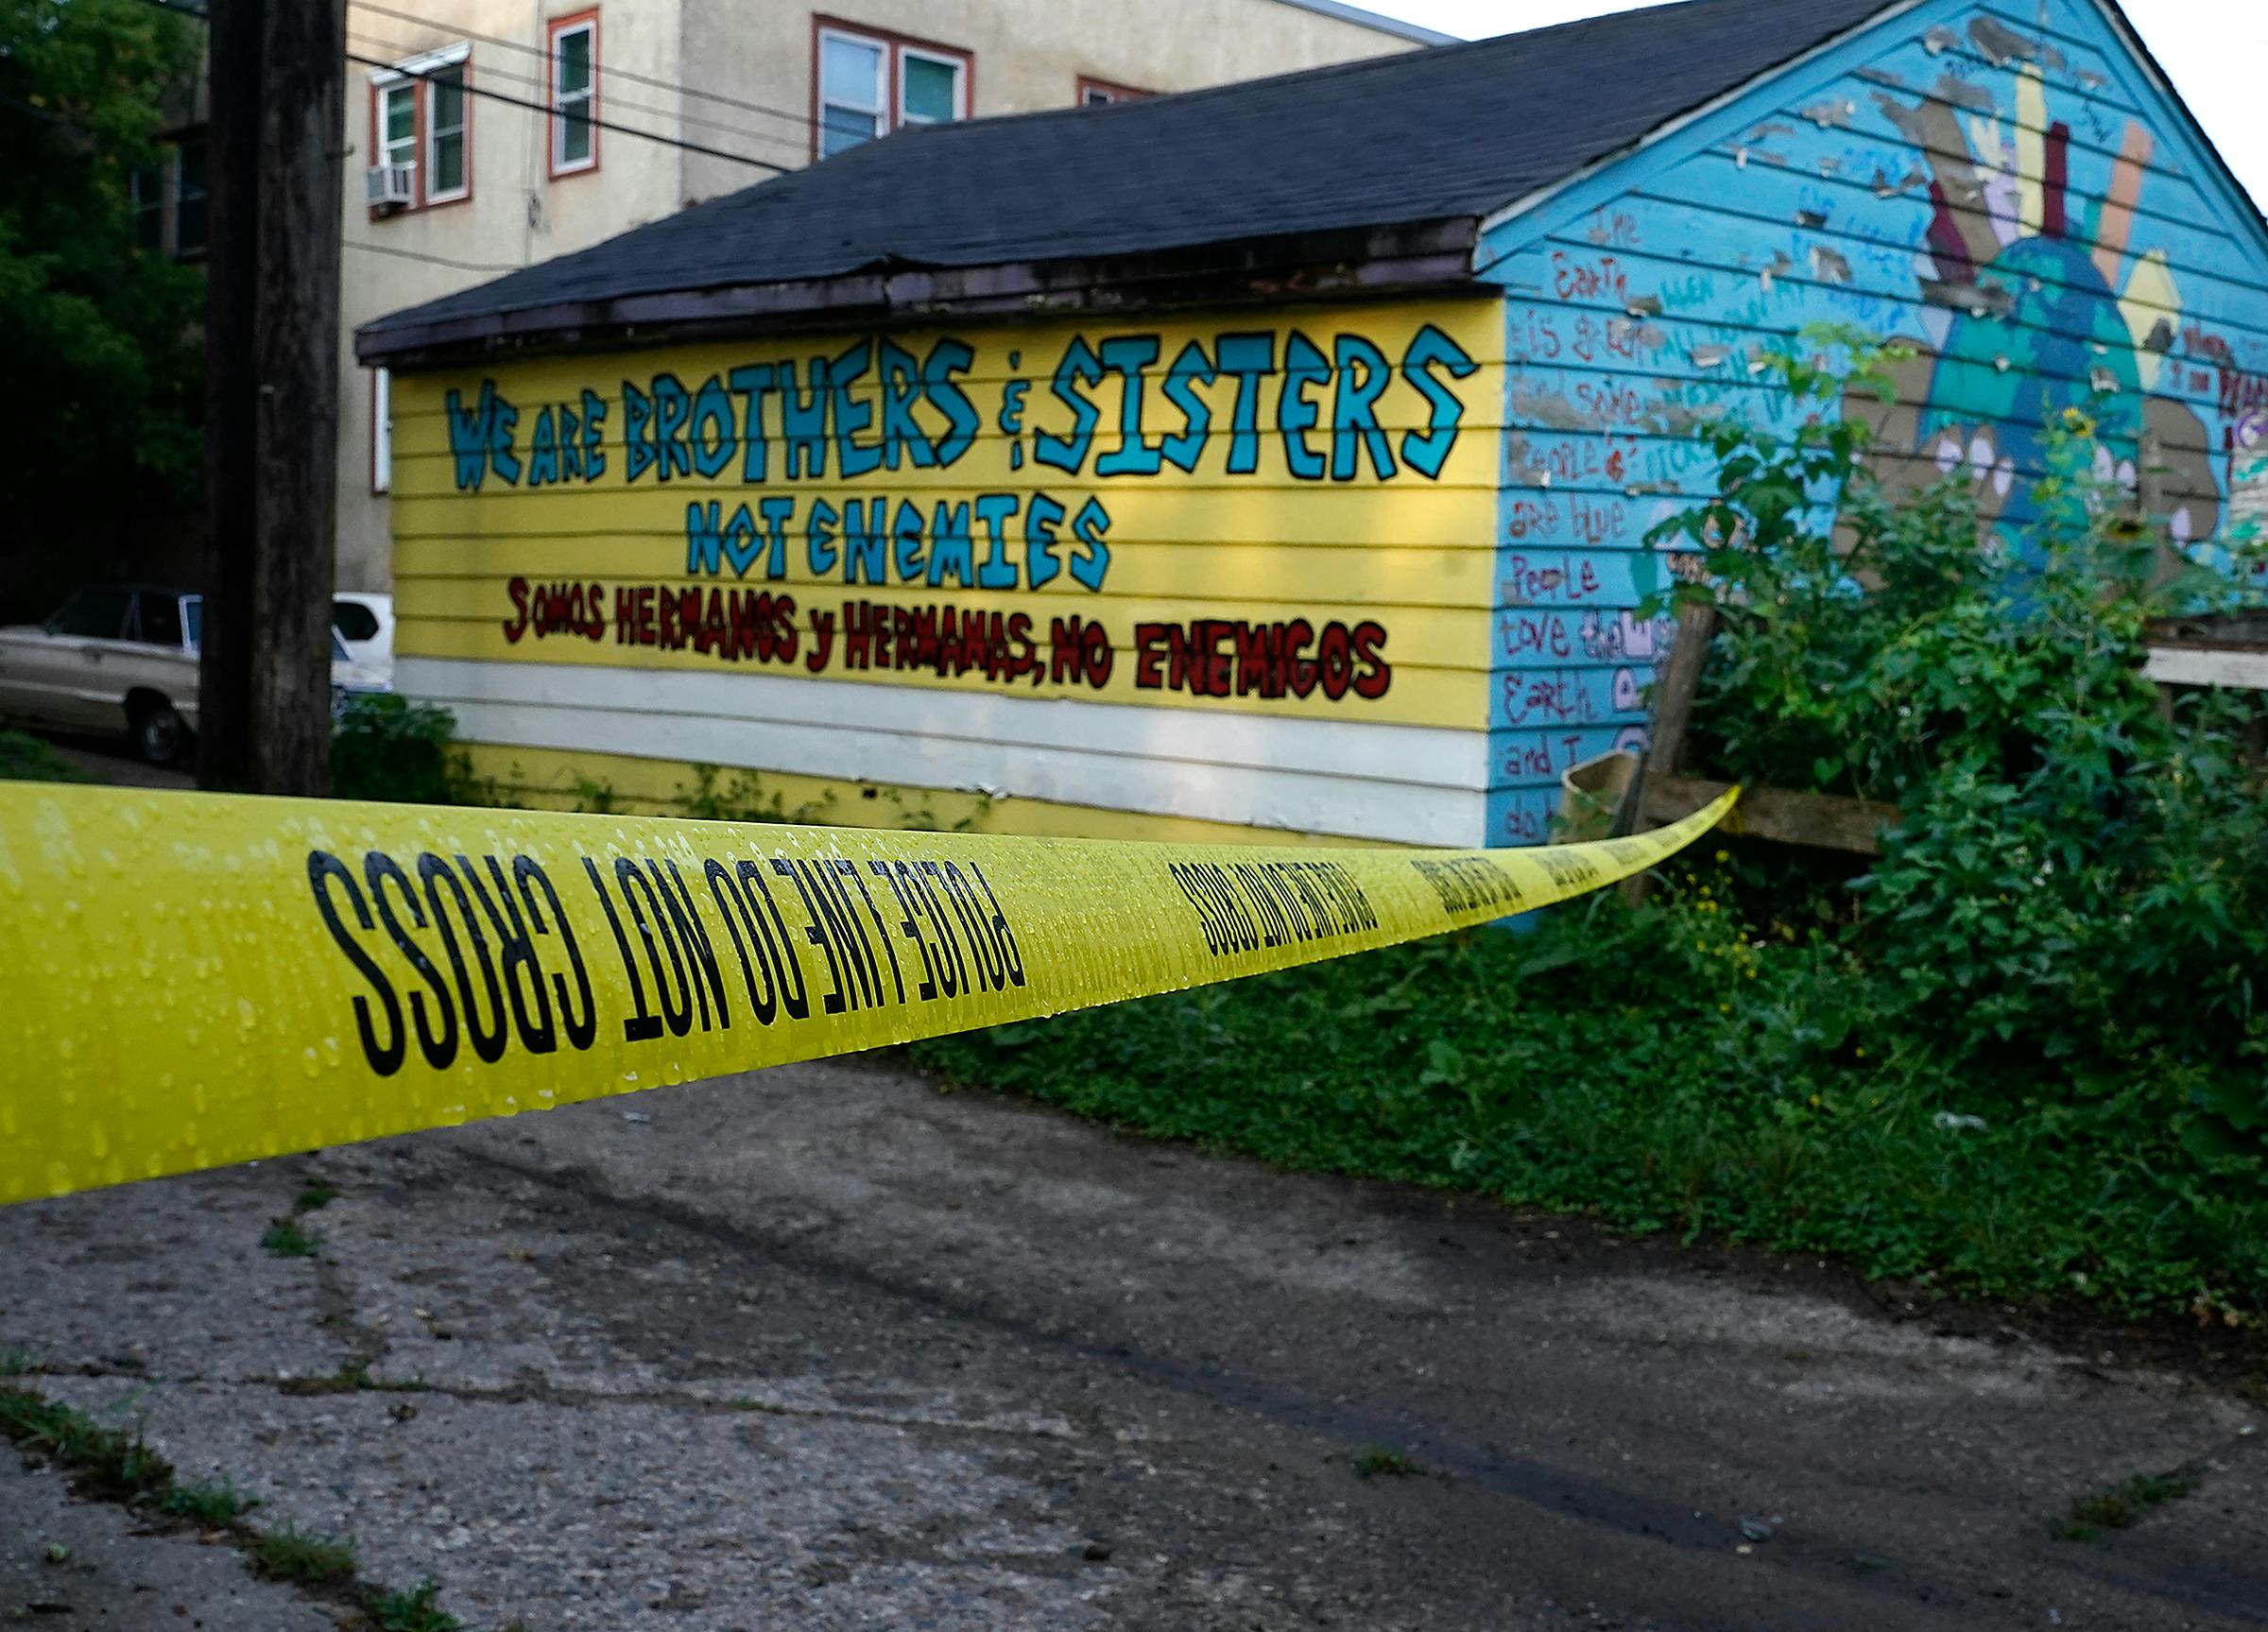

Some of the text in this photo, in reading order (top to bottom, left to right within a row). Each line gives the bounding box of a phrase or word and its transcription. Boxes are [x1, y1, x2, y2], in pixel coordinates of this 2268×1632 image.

[445, 378, 523, 492] WE
[528, 387, 608, 486] ARE
[622, 336, 980, 483] BROTHERS
[1033, 322, 1481, 480] SISTERS
[686, 491, 1111, 592] NOT ENEMIES
[503, 576, 607, 644] SOMOS
[616, 586, 798, 663] HERMANOS
[1050, 613, 1114, 690] NO
[1135, 619, 1391, 701] ENEMIGOS
[307, 849, 1025, 1077] POLICE LINE DO NOT CROSS
